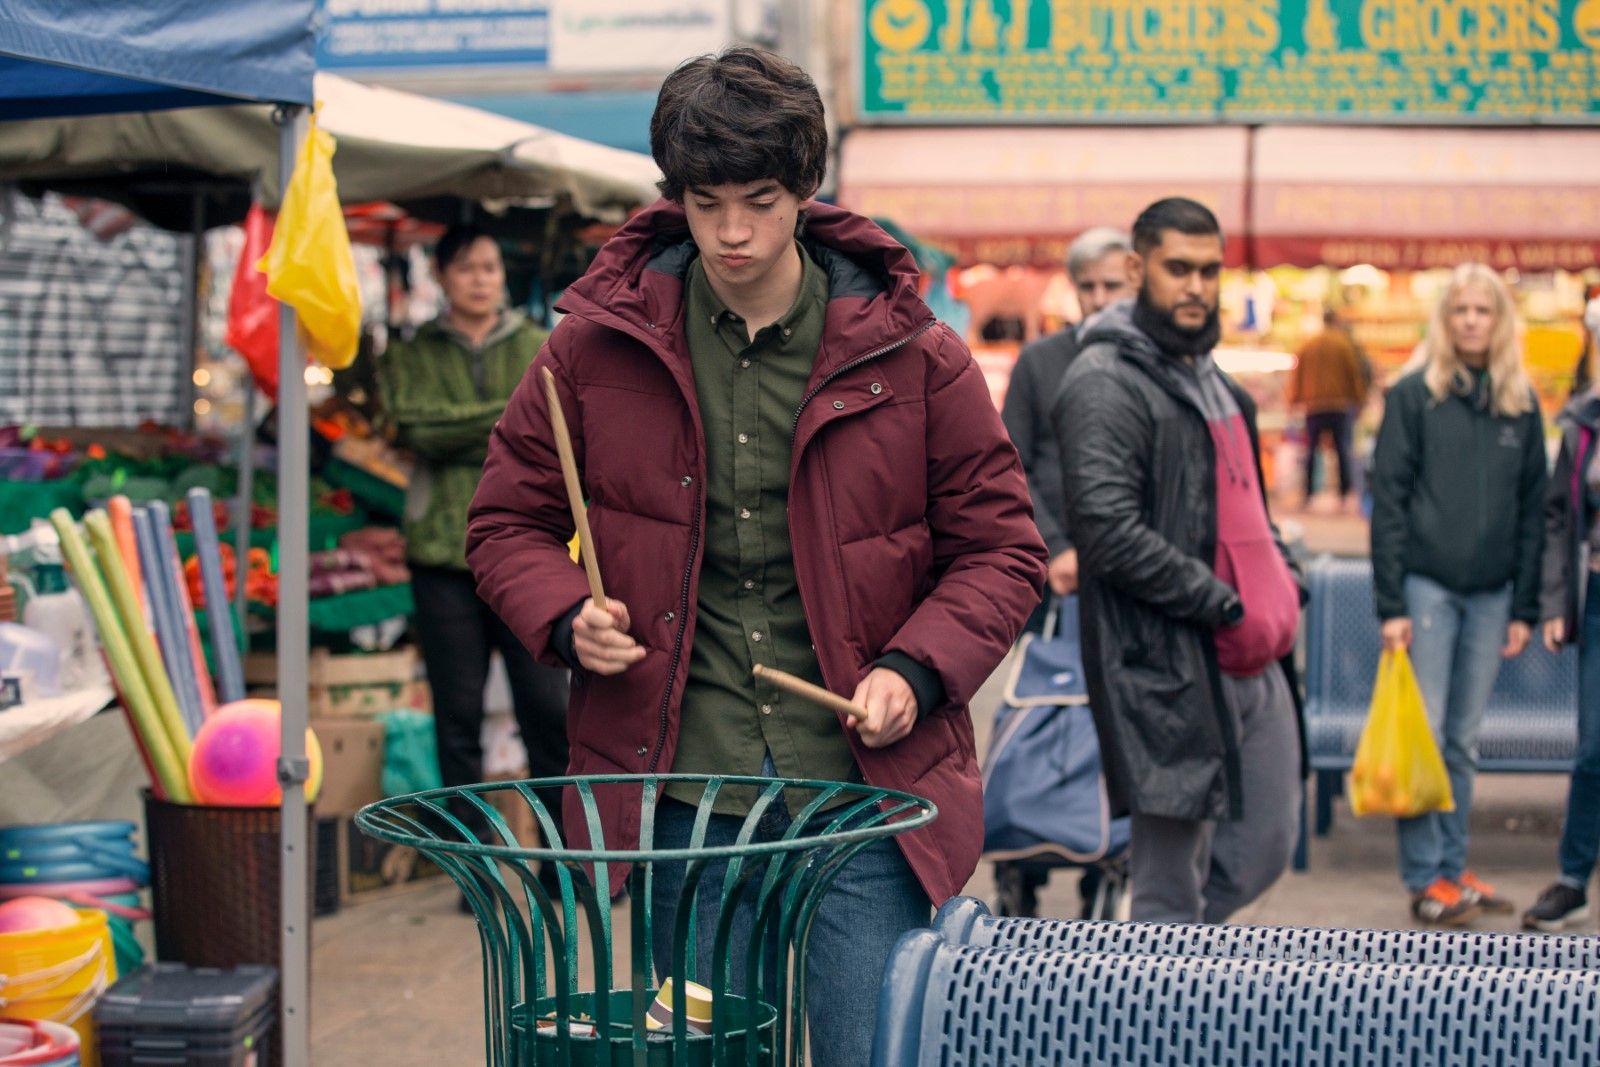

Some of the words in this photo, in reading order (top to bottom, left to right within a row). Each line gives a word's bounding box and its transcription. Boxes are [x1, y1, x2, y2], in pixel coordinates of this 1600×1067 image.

[1051, 0, 1279, 50] BUTCHERS
[1303, 0, 1338, 50] &
[1360, 0, 1560, 50] GROCERS
